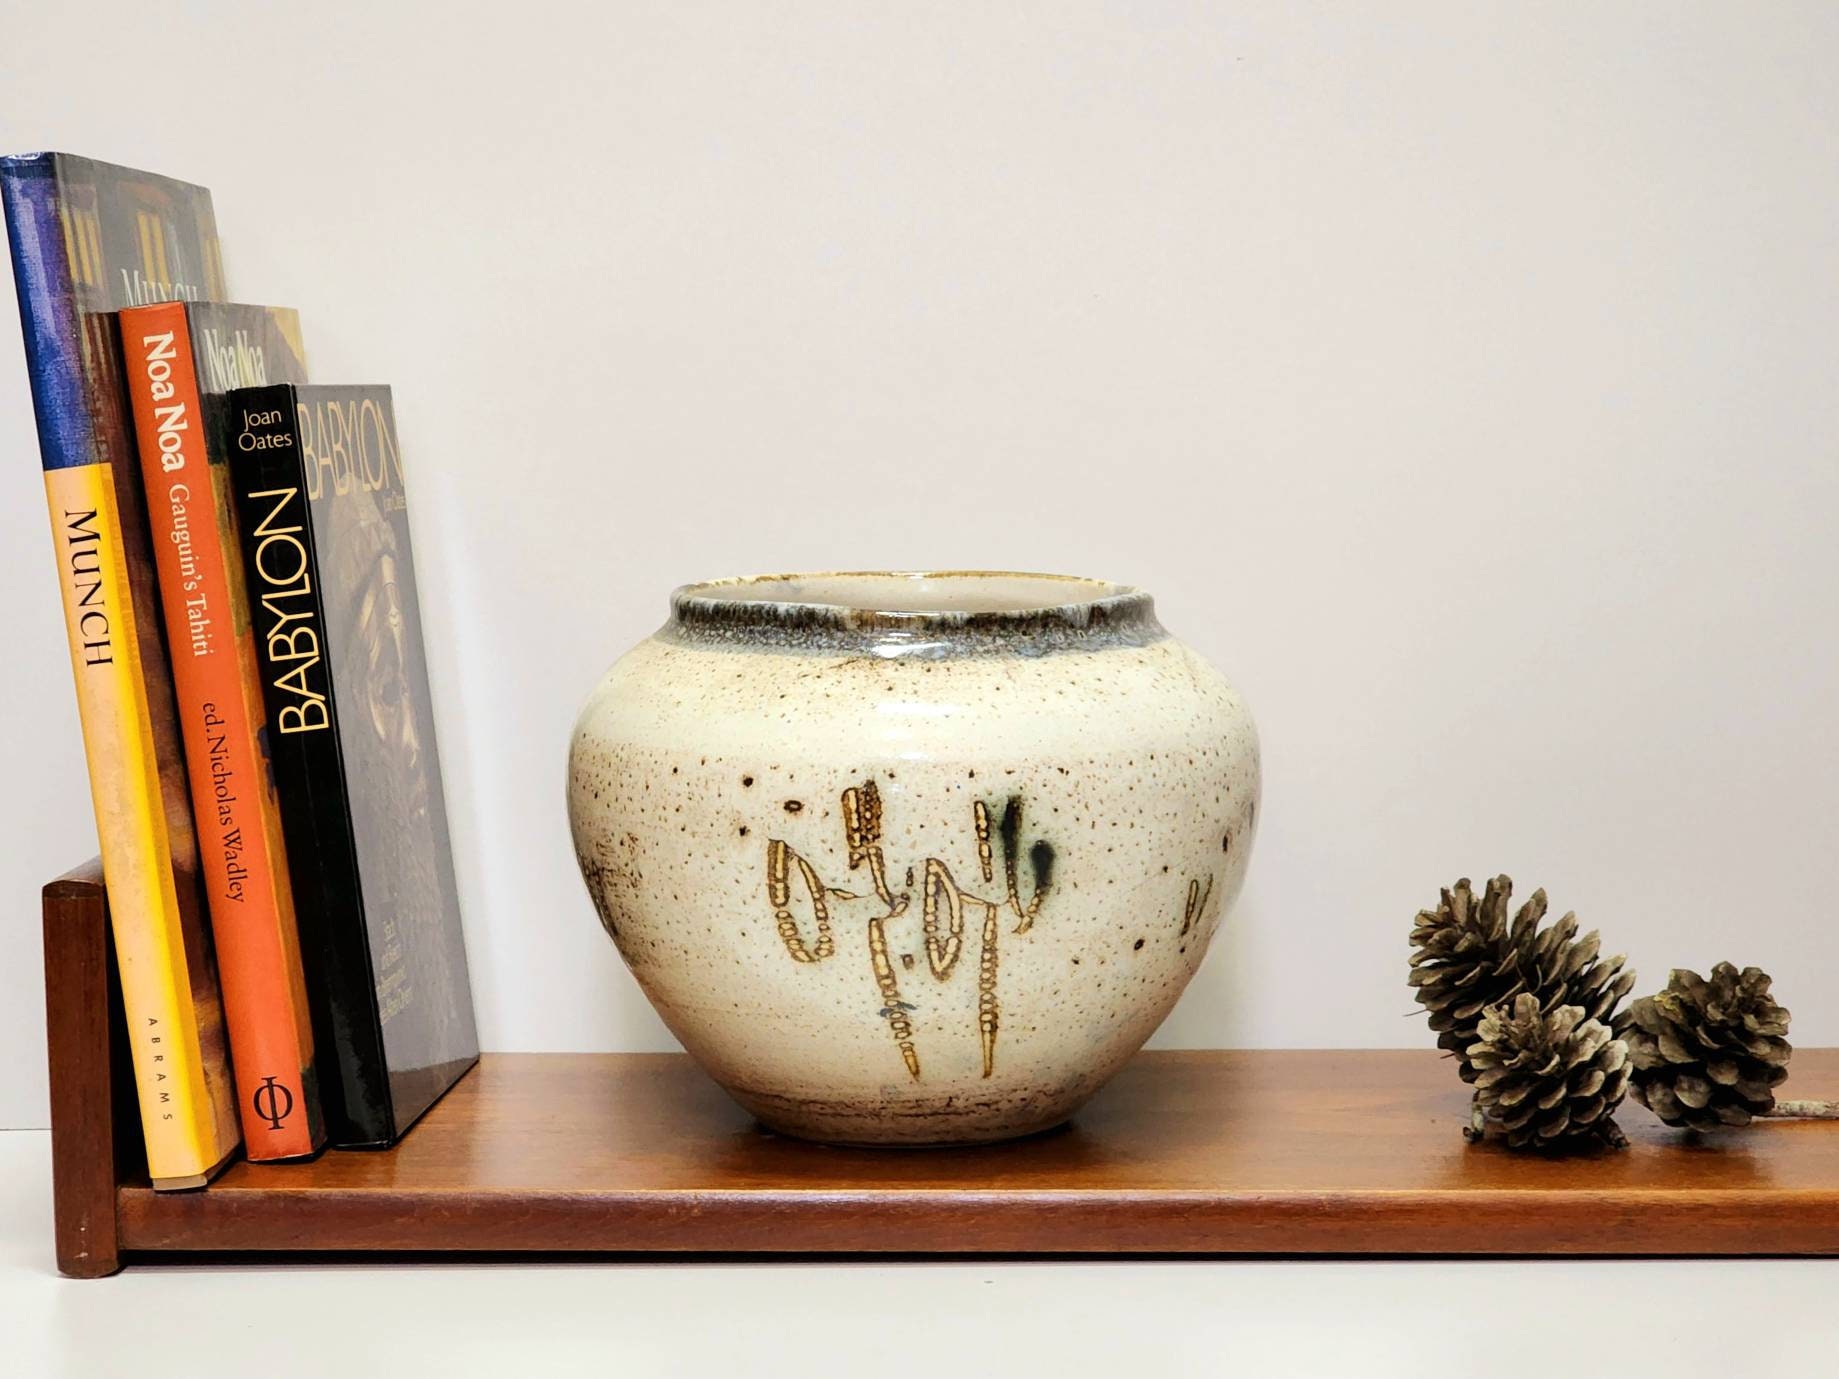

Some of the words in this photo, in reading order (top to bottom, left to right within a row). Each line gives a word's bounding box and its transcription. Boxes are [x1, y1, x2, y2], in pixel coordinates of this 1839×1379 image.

[143, 330, 176, 401] Noa
[203, 328, 240, 392] Noa
[235, 329, 267, 388] Noa
[155, 402, 189, 473] Noa
[238, 432, 293, 452] Oates
[243, 409, 282, 432] Joan
[297, 399, 406, 500] BABYLON
[64, 507, 114, 668] MUNCH
[169, 483, 203, 591] Gauguin's
[186, 593, 214, 657] Tahiti
[247, 487, 330, 734] BABYLON
[202, 702, 225, 733] ed.
[207, 734, 237, 826] Nicholas
[222, 825, 249, 903] Wadley
[148, 1017, 173, 1121] ABRAMS
